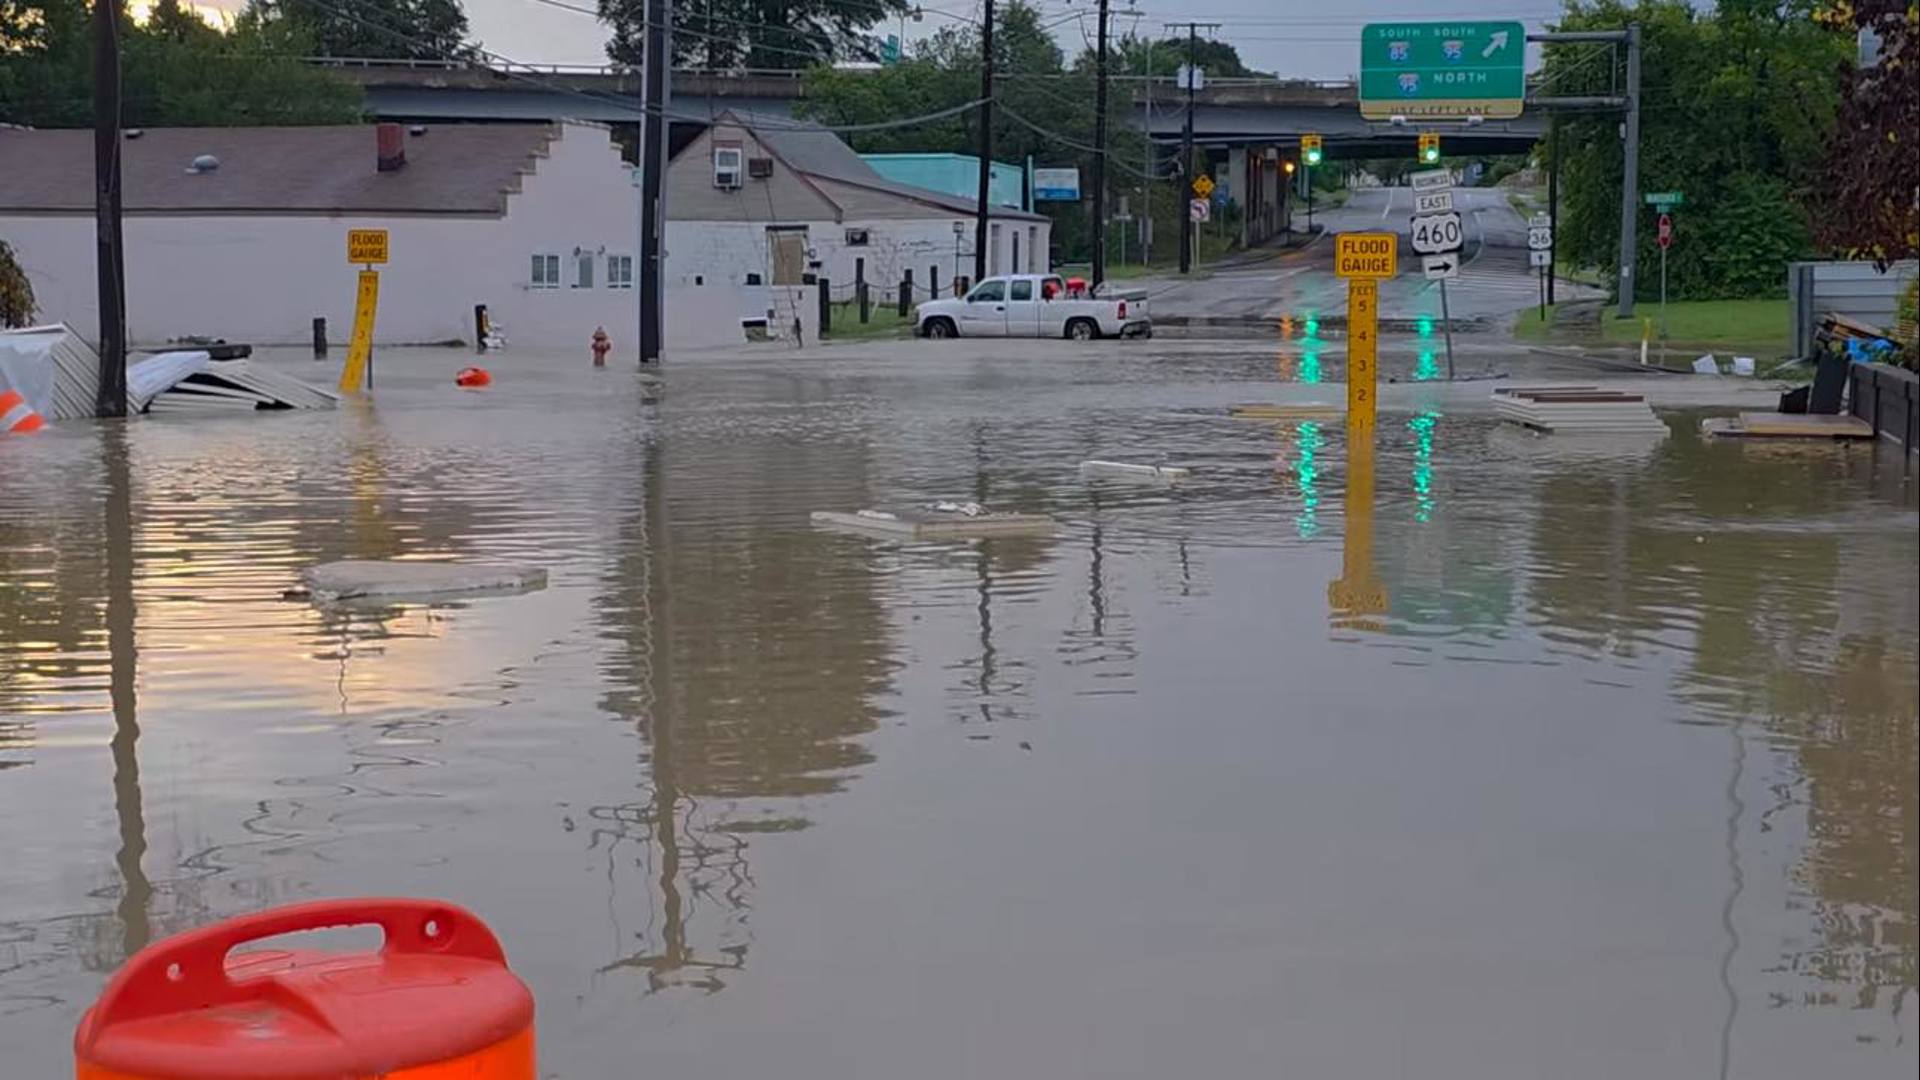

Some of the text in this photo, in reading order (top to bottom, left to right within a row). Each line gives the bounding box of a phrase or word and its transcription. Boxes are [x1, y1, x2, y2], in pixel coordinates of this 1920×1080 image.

[1378, 27, 1476, 38] SOUTH SOUTH
[1390, 47, 1461, 60] 85 95
[1400, 72, 1487, 92] 95 NORTH
[1458, 104, 1490, 115] LANE
[1420, 196, 1446, 209] EAST
[1416, 221, 1458, 245] 460
[352, 234, 383, 245] FLOOD
[1342, 239, 1390, 254] FLOOD
[351, 247, 383, 259] GAUGE
[1342, 257, 1390, 272] GAUGE
[1350, 285, 1375, 296] FEET
[1359, 300, 1367, 312] 5
[1358, 330, 1367, 341] 4
[1358, 359, 1367, 371] 3
[1357, 388, 1366, 401] 2
